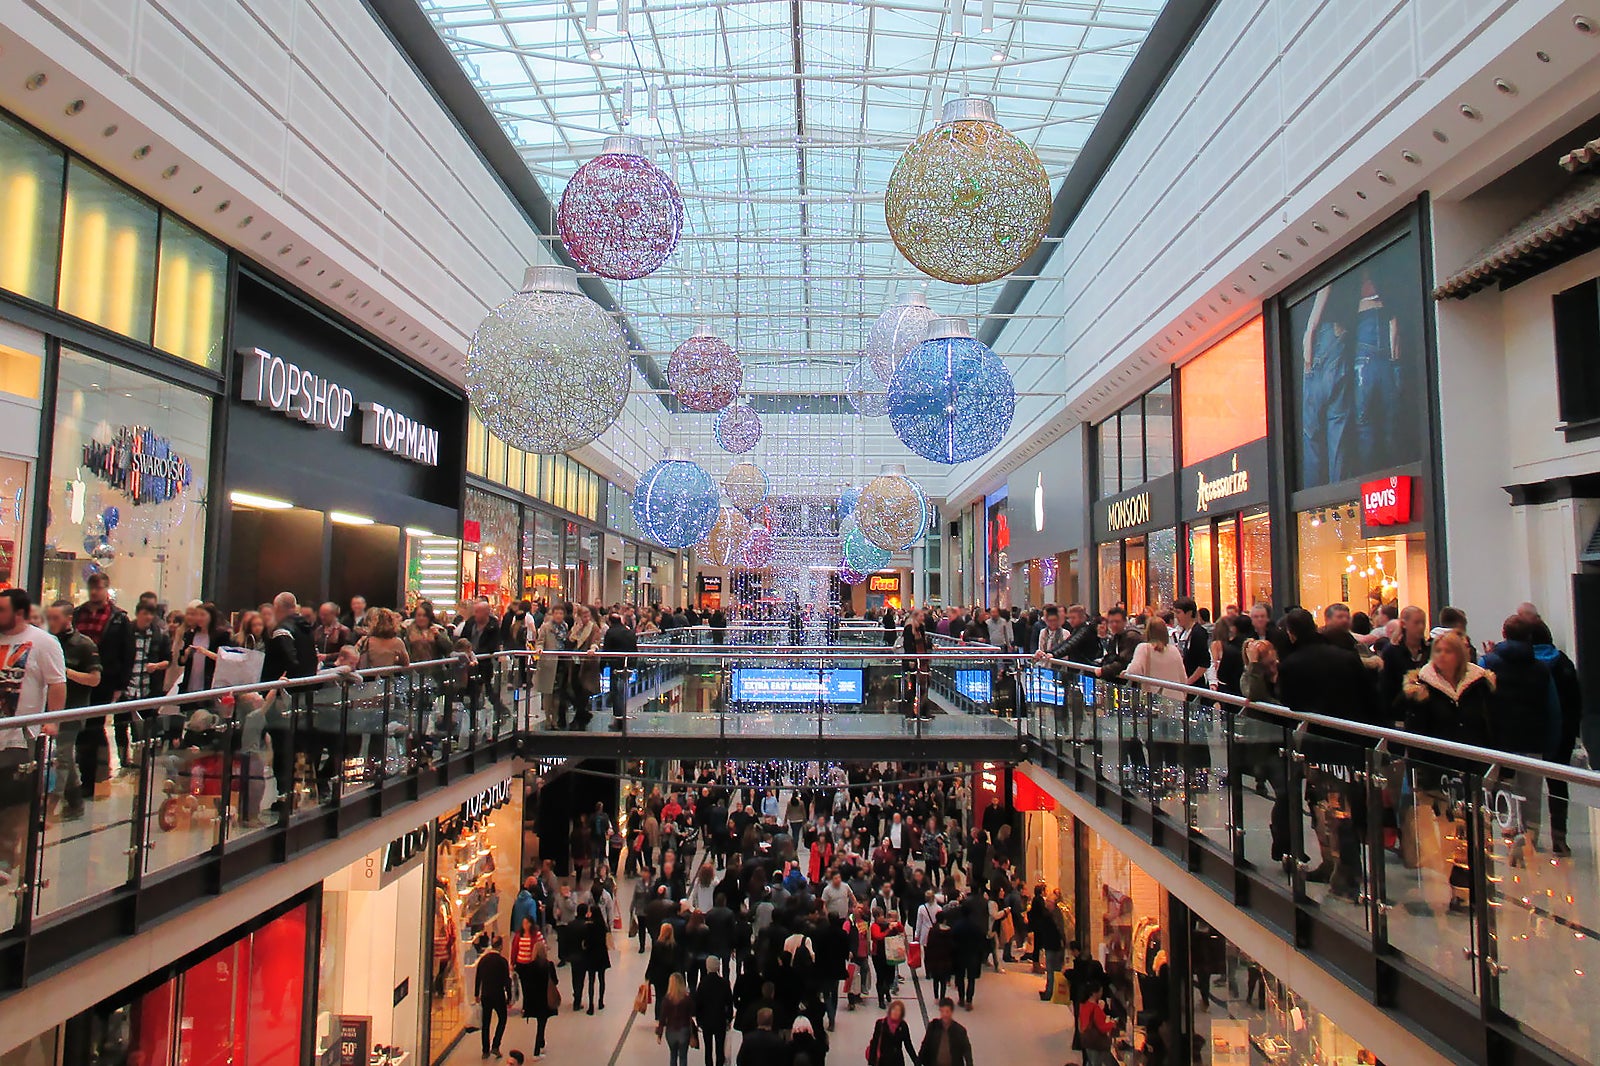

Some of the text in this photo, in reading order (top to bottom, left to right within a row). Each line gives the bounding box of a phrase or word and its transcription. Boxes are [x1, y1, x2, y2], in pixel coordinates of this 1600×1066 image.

[254, 347, 353, 432] TOPSHOP
[373, 402, 439, 466] TOPMAN
[133, 452, 186, 481] SWAROVSKI
[1197, 452, 1248, 512] Accessorize
[1108, 491, 1150, 531] MONSOON
